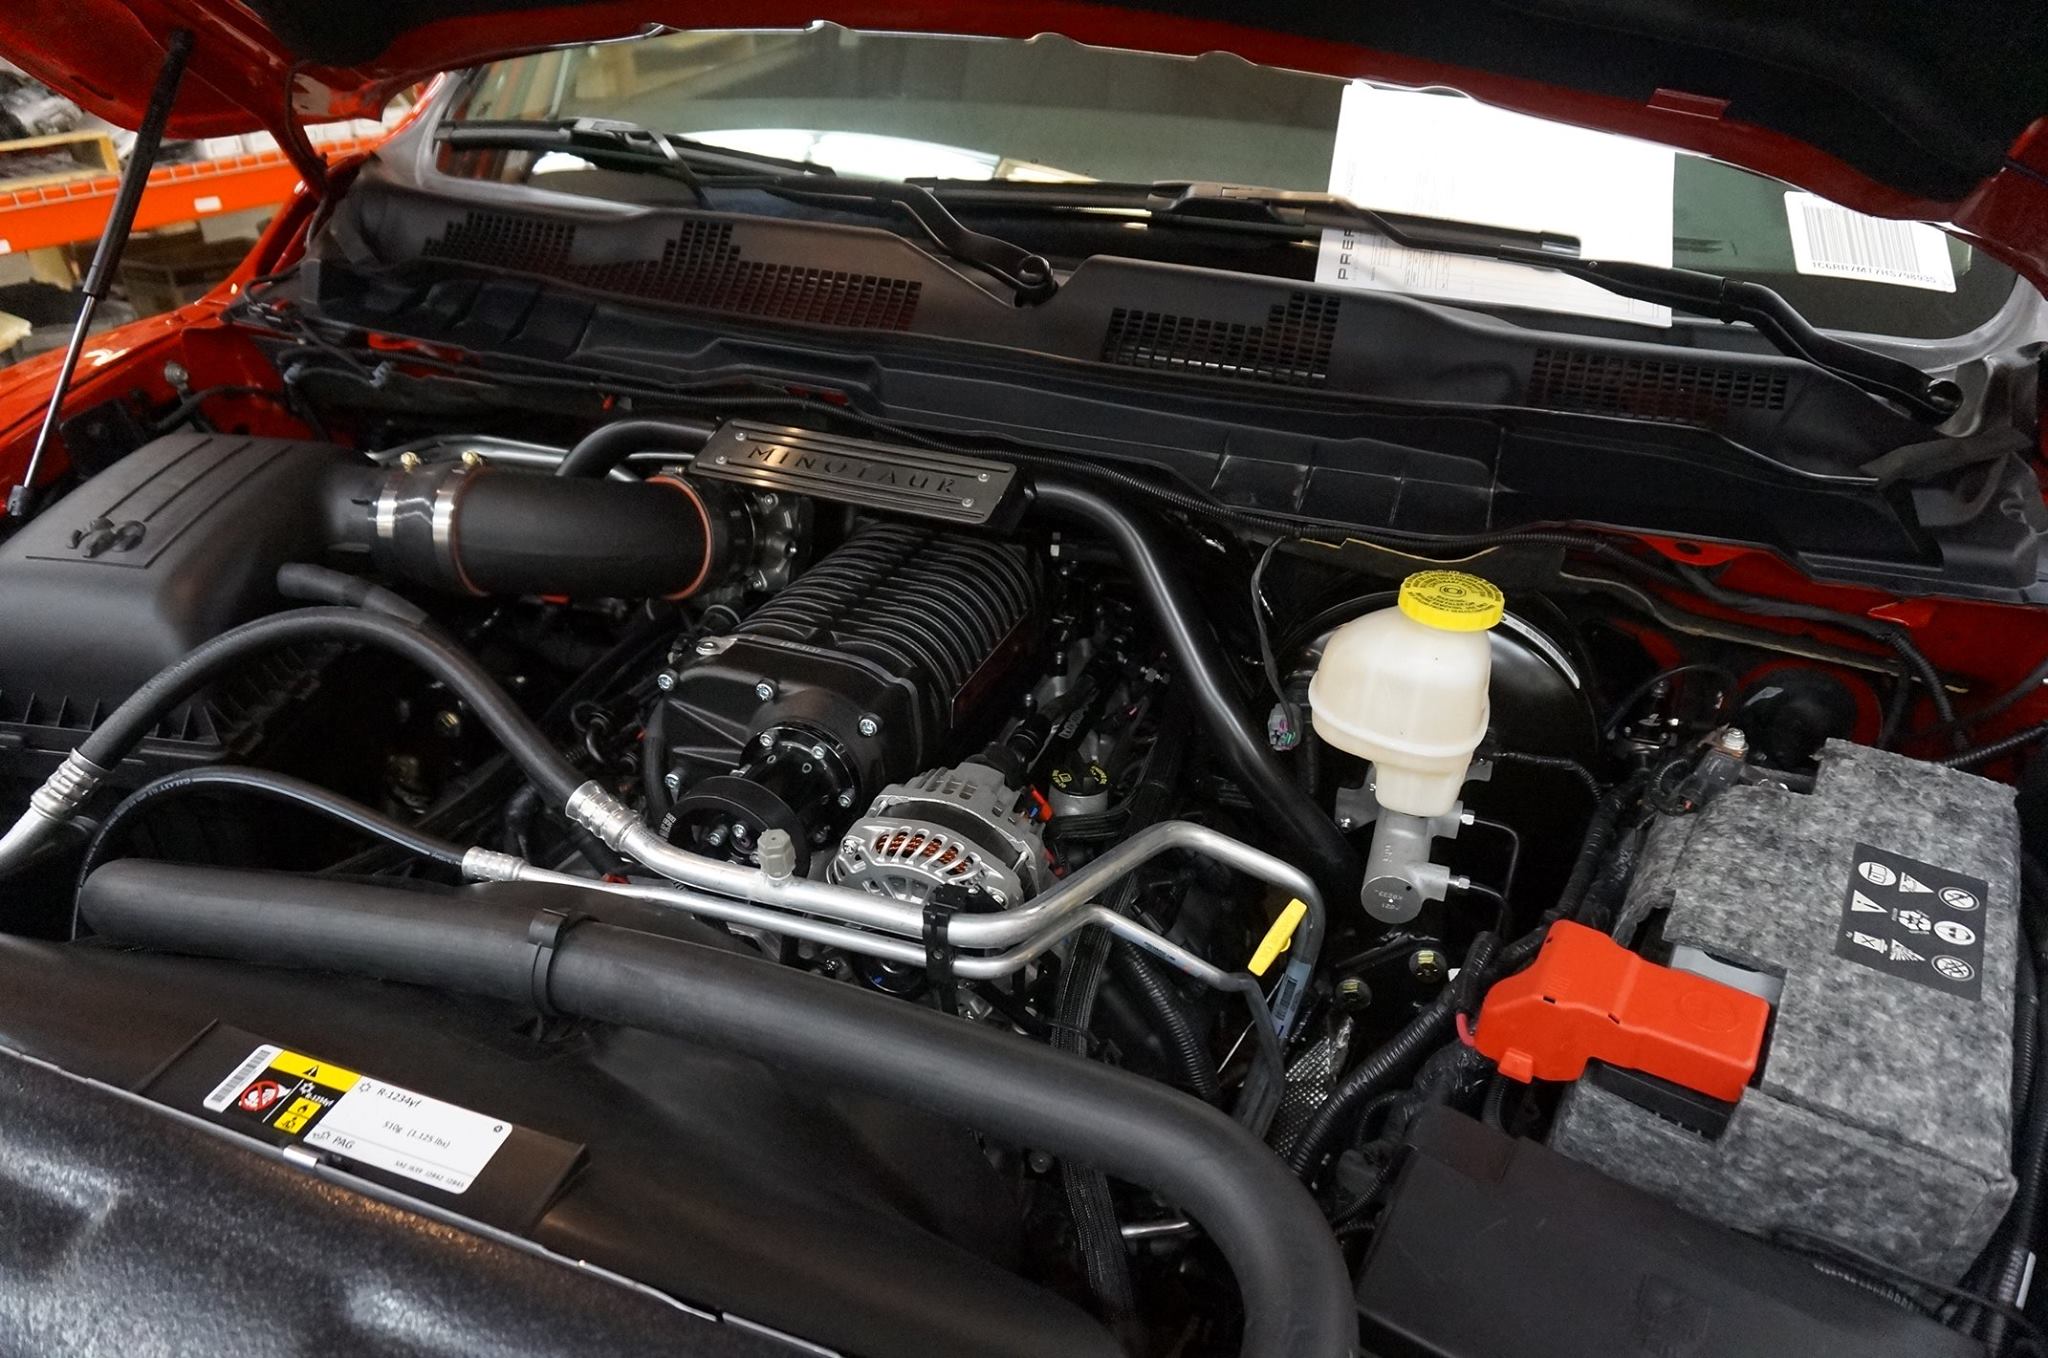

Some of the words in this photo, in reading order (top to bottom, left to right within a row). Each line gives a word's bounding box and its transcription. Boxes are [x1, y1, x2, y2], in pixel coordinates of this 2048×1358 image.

[747, 447, 956, 492] MINOTAUR
[377, 1088, 422, 1108] R-1234yf
[332, 1137, 355, 1150] PAG
